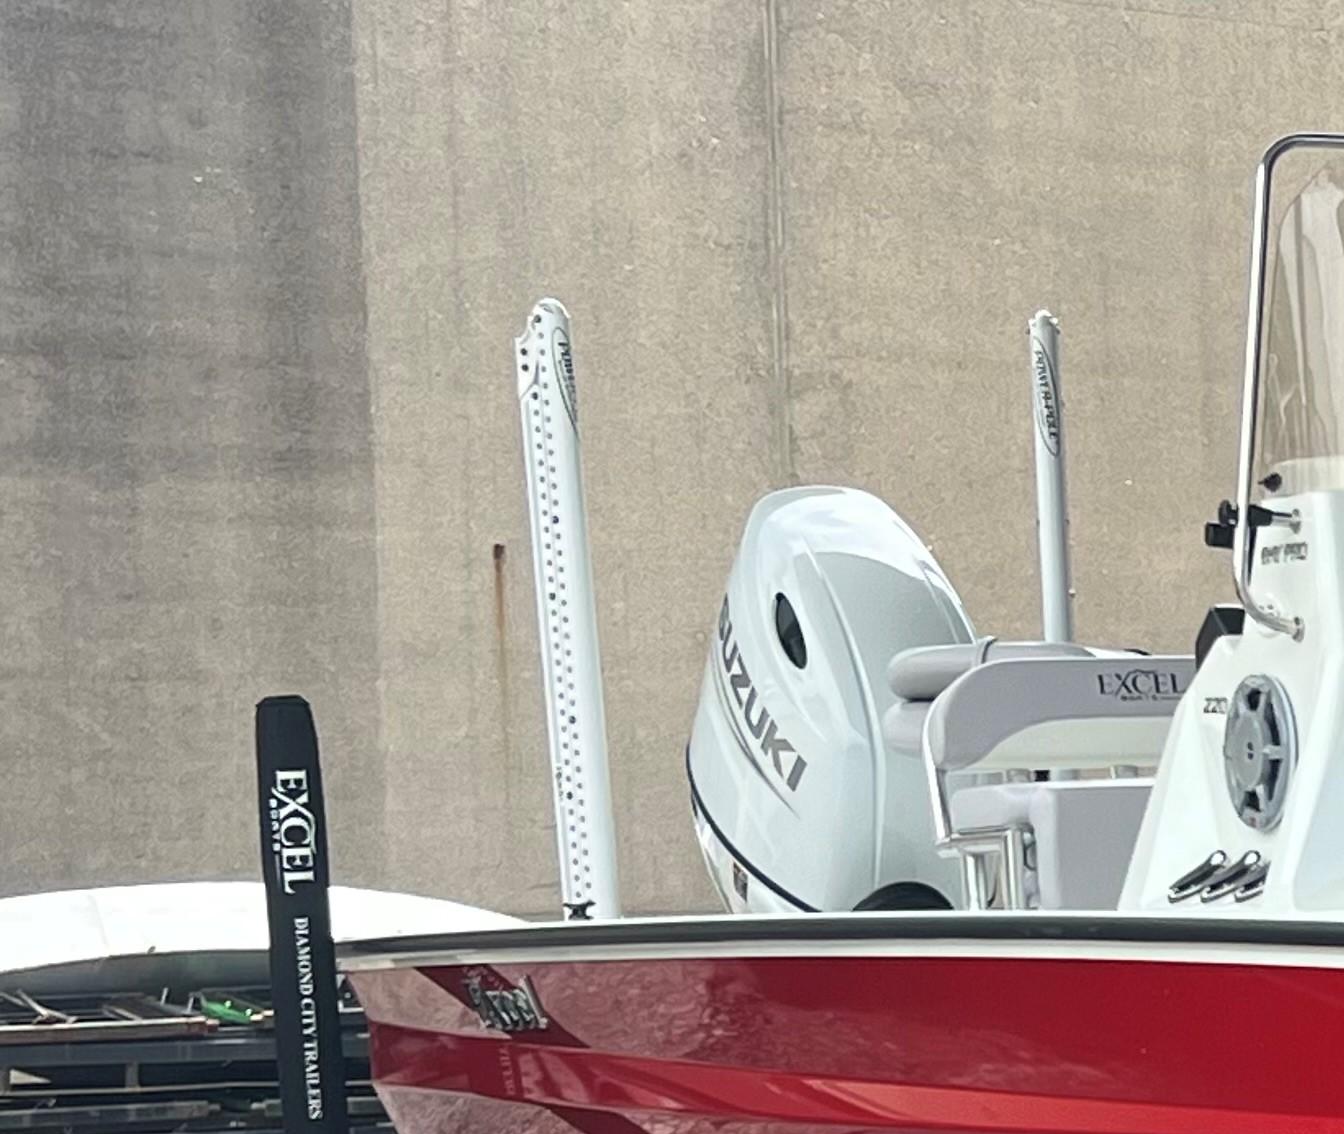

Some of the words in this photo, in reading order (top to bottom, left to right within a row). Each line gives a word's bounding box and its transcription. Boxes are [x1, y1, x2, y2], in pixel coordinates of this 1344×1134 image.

[719, 593, 808, 792] SUZUKI
[1098, 669, 1187, 697] EXCEL
[272, 769, 317, 894] EXCEL
[294, 917, 314, 996] DIAMOND
[301, 998, 317, 1038] CITY
[303, 1040, 323, 1120] TRAILERS
